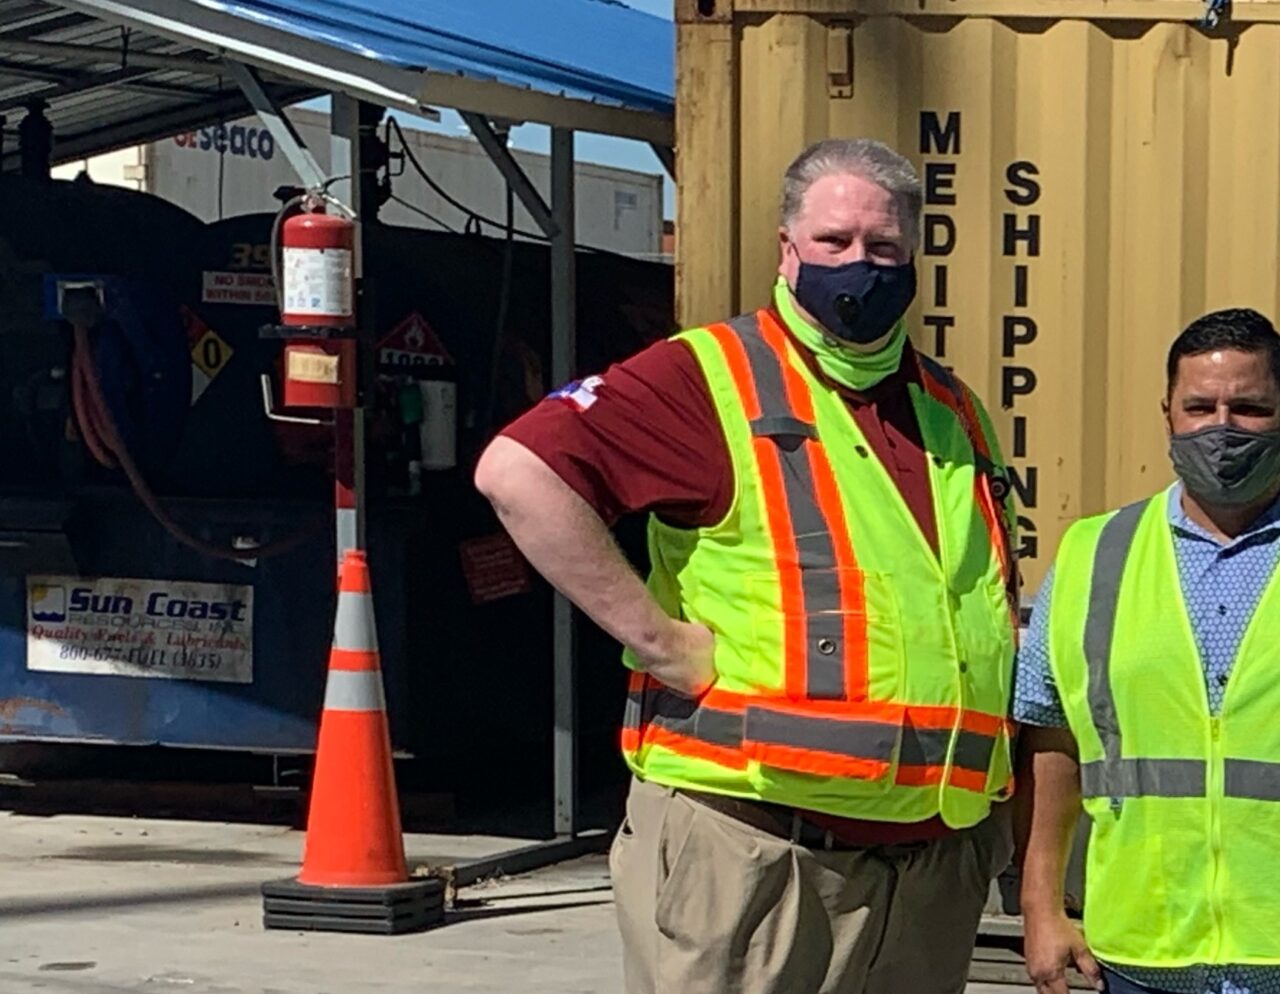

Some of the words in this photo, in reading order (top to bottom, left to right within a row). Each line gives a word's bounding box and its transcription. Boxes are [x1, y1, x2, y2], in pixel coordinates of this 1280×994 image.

[919, 111, 961, 373] MEDIT
[204, 338, 222, 368] 0
[1003, 161, 1041, 558] SHIPPING
[69, 588, 133, 614] Sun
[146, 592, 247, 621] Coast
